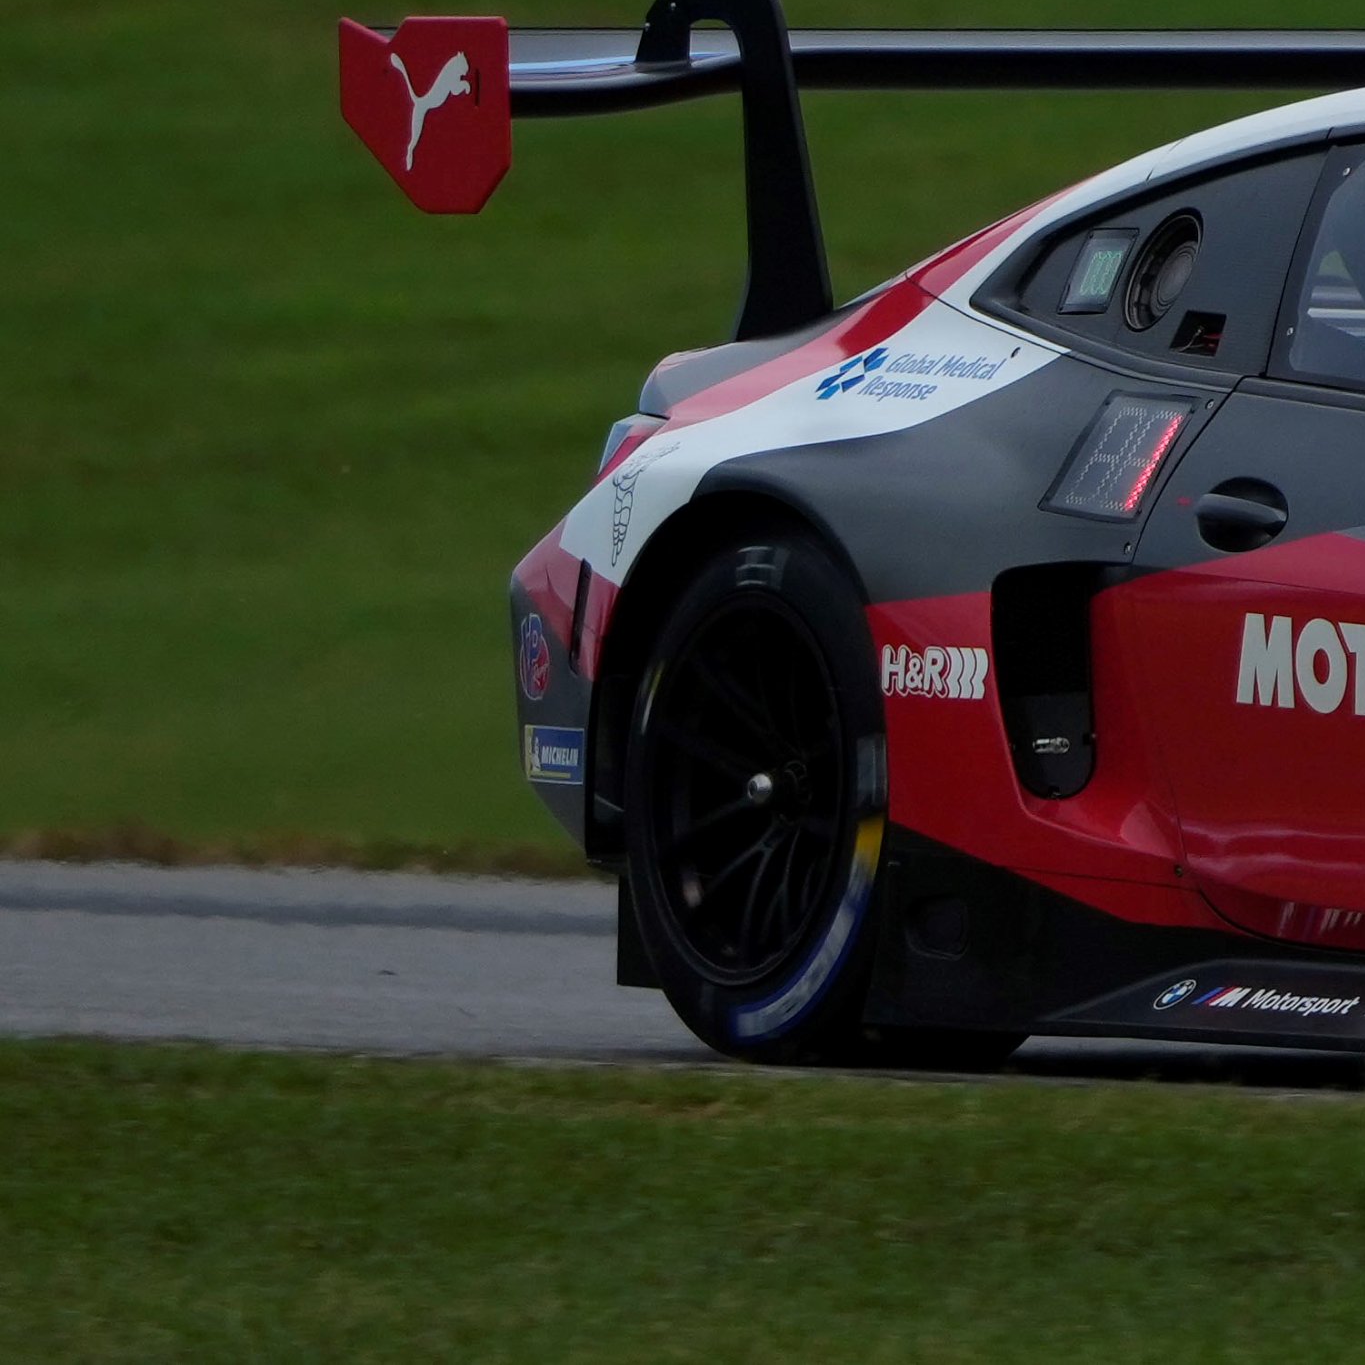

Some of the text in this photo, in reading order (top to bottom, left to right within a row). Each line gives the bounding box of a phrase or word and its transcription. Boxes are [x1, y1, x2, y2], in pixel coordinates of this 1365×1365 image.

[885, 353, 1007, 381] Global Medical
[857, 375, 938, 402] Response
[881, 644, 949, 698] H&R
[541, 745, 579, 767] MICHELIN
[1241, 988, 1361, 1017] Motorsport
